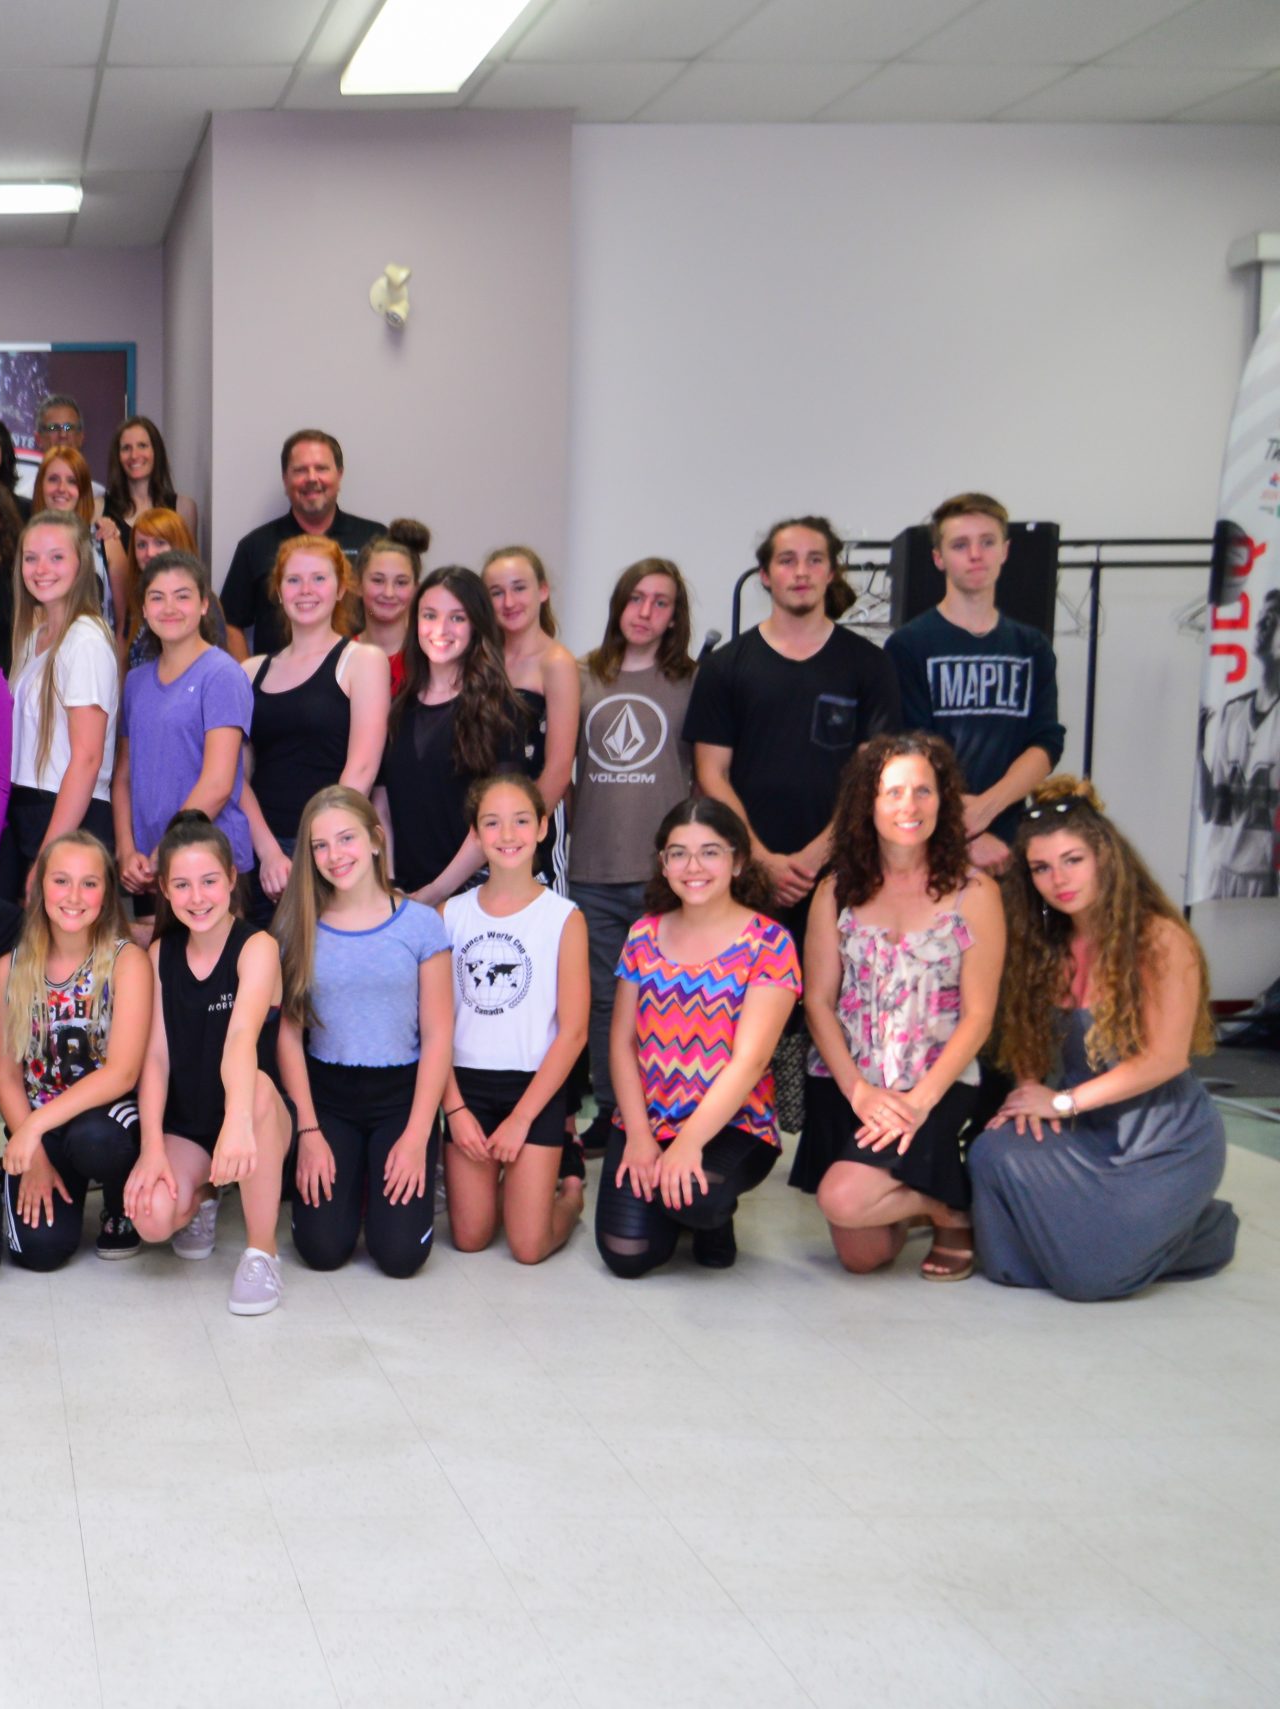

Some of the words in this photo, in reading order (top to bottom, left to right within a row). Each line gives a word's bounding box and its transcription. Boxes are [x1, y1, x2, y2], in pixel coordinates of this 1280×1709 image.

[940, 662, 1021, 708] MAPLE
[588, 772, 656, 784] VOLCOM
[487, 932, 513, 941] World
[220, 993, 232, 1001] NO
[474, 1006, 504, 1015] Canada
